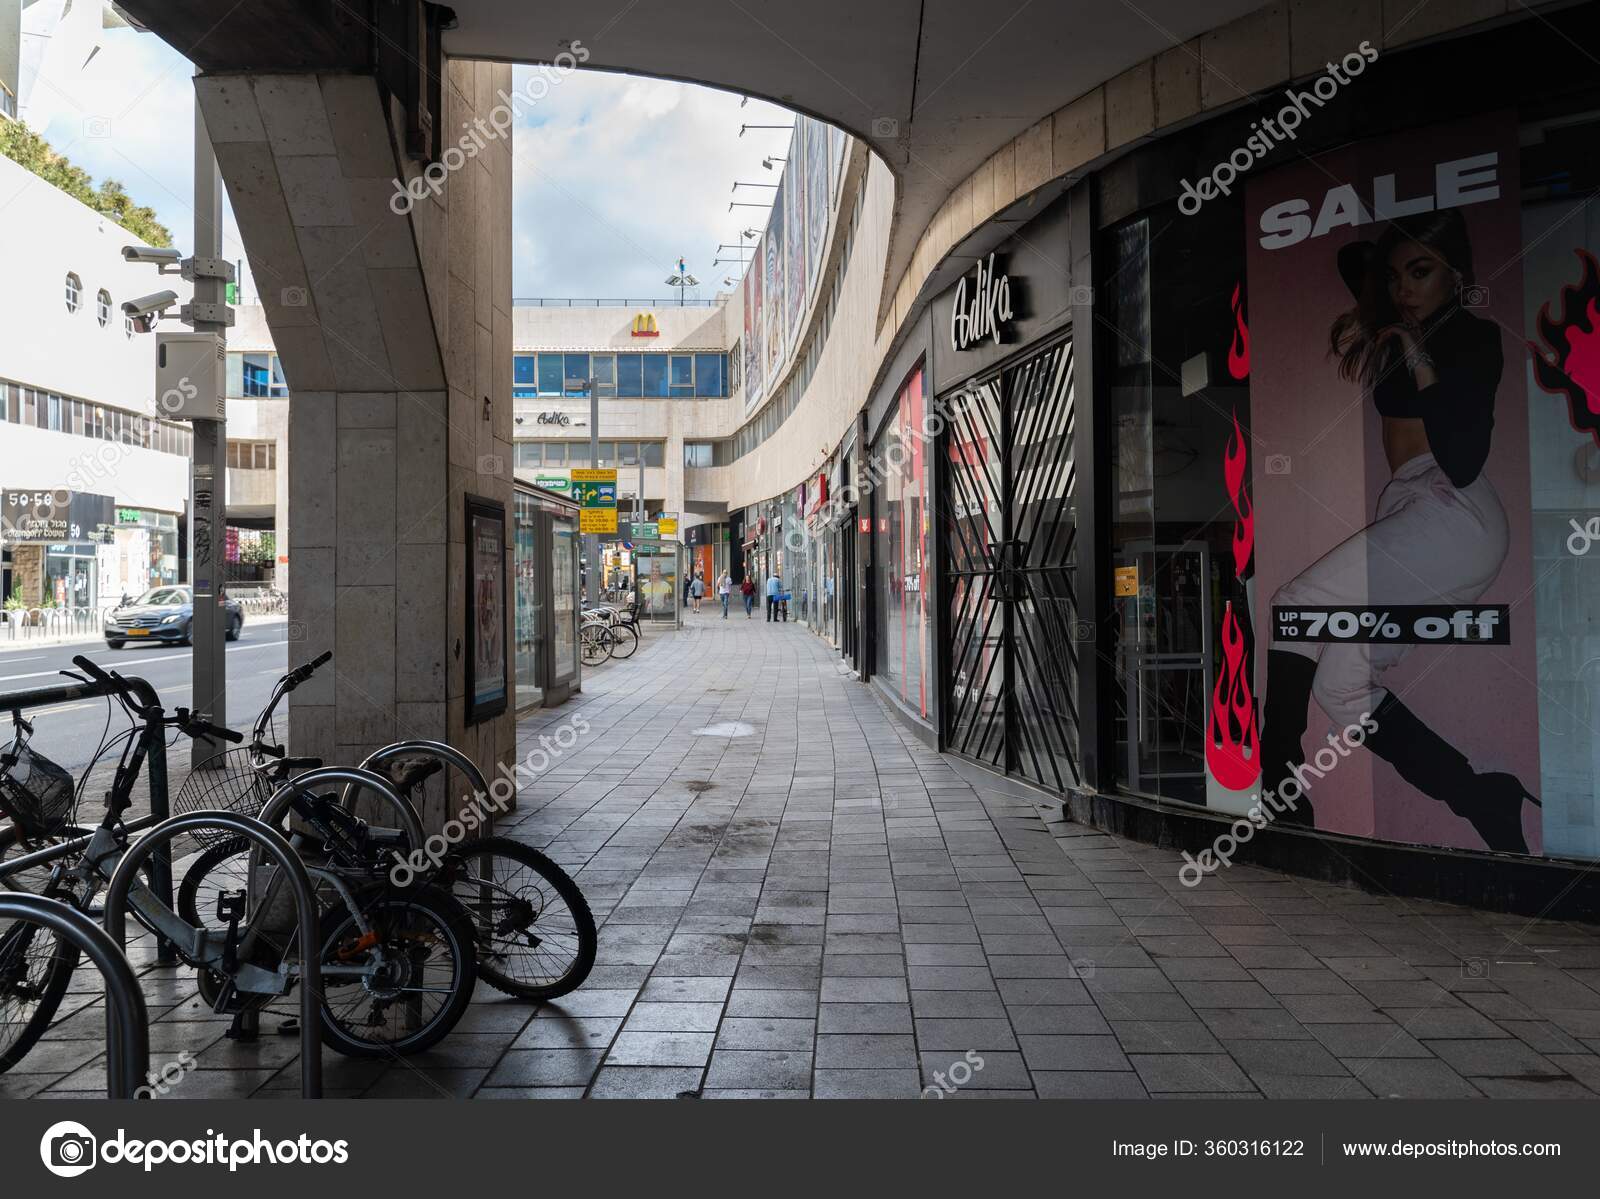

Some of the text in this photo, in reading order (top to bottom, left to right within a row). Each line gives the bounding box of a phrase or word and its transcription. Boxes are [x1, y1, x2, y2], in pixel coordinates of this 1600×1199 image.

[1259, 152, 1500, 250] SALE
[951, 252, 1013, 352] Adika
[537, 411, 570, 427] Adika
[70, 523, 81, 538] 50
[1279, 611, 1299, 623] UP
[1300, 609, 1500, 640] 70% off
[1280, 625, 1299, 637] TO
